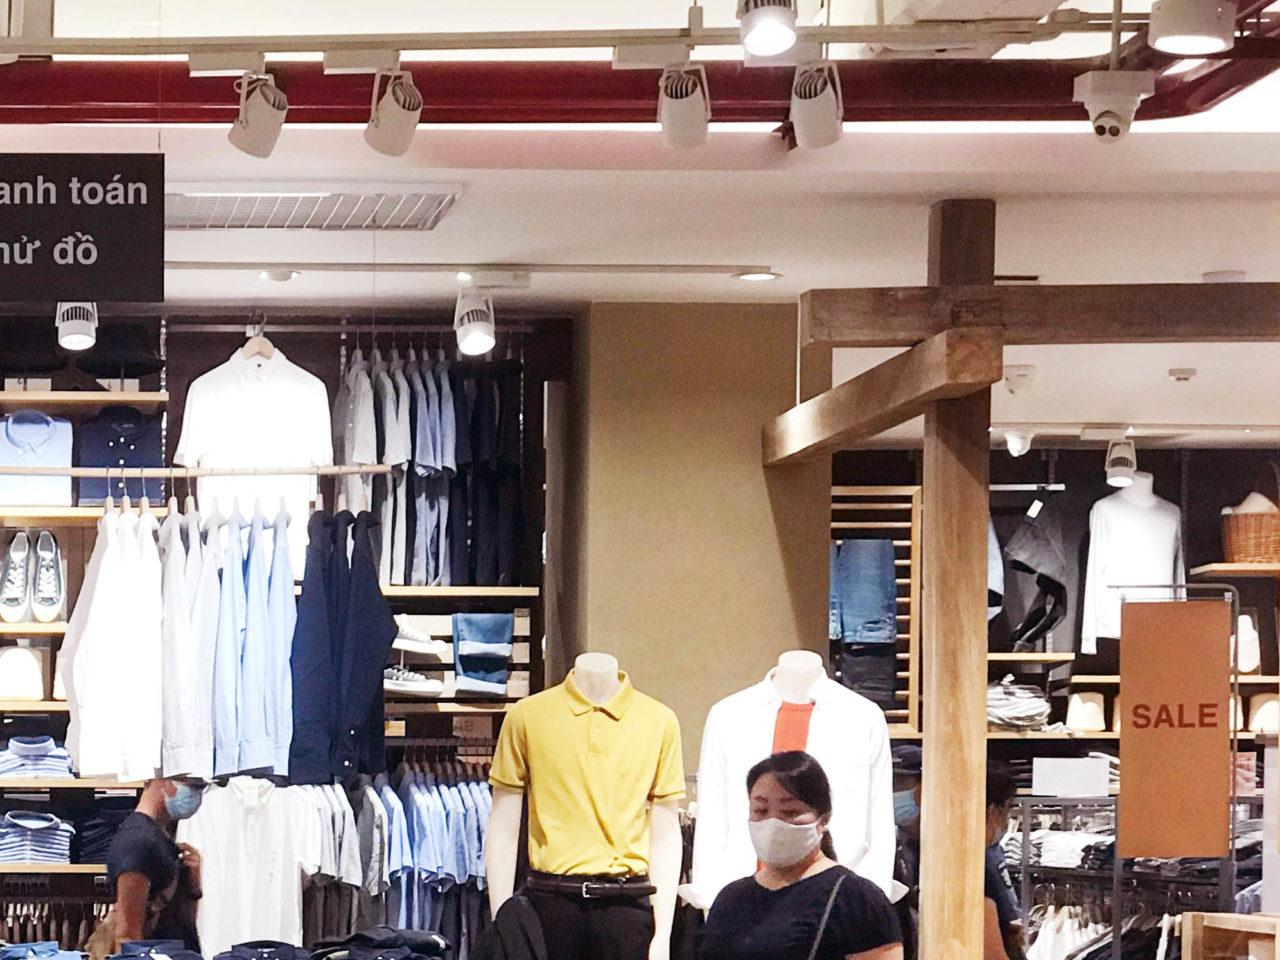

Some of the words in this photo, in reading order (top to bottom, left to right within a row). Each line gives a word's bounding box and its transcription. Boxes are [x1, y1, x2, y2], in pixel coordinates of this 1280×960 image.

[69, 174, 147, 205] toán
[53, 231, 98, 265] đồ
[1131, 703, 1218, 729] SALE
